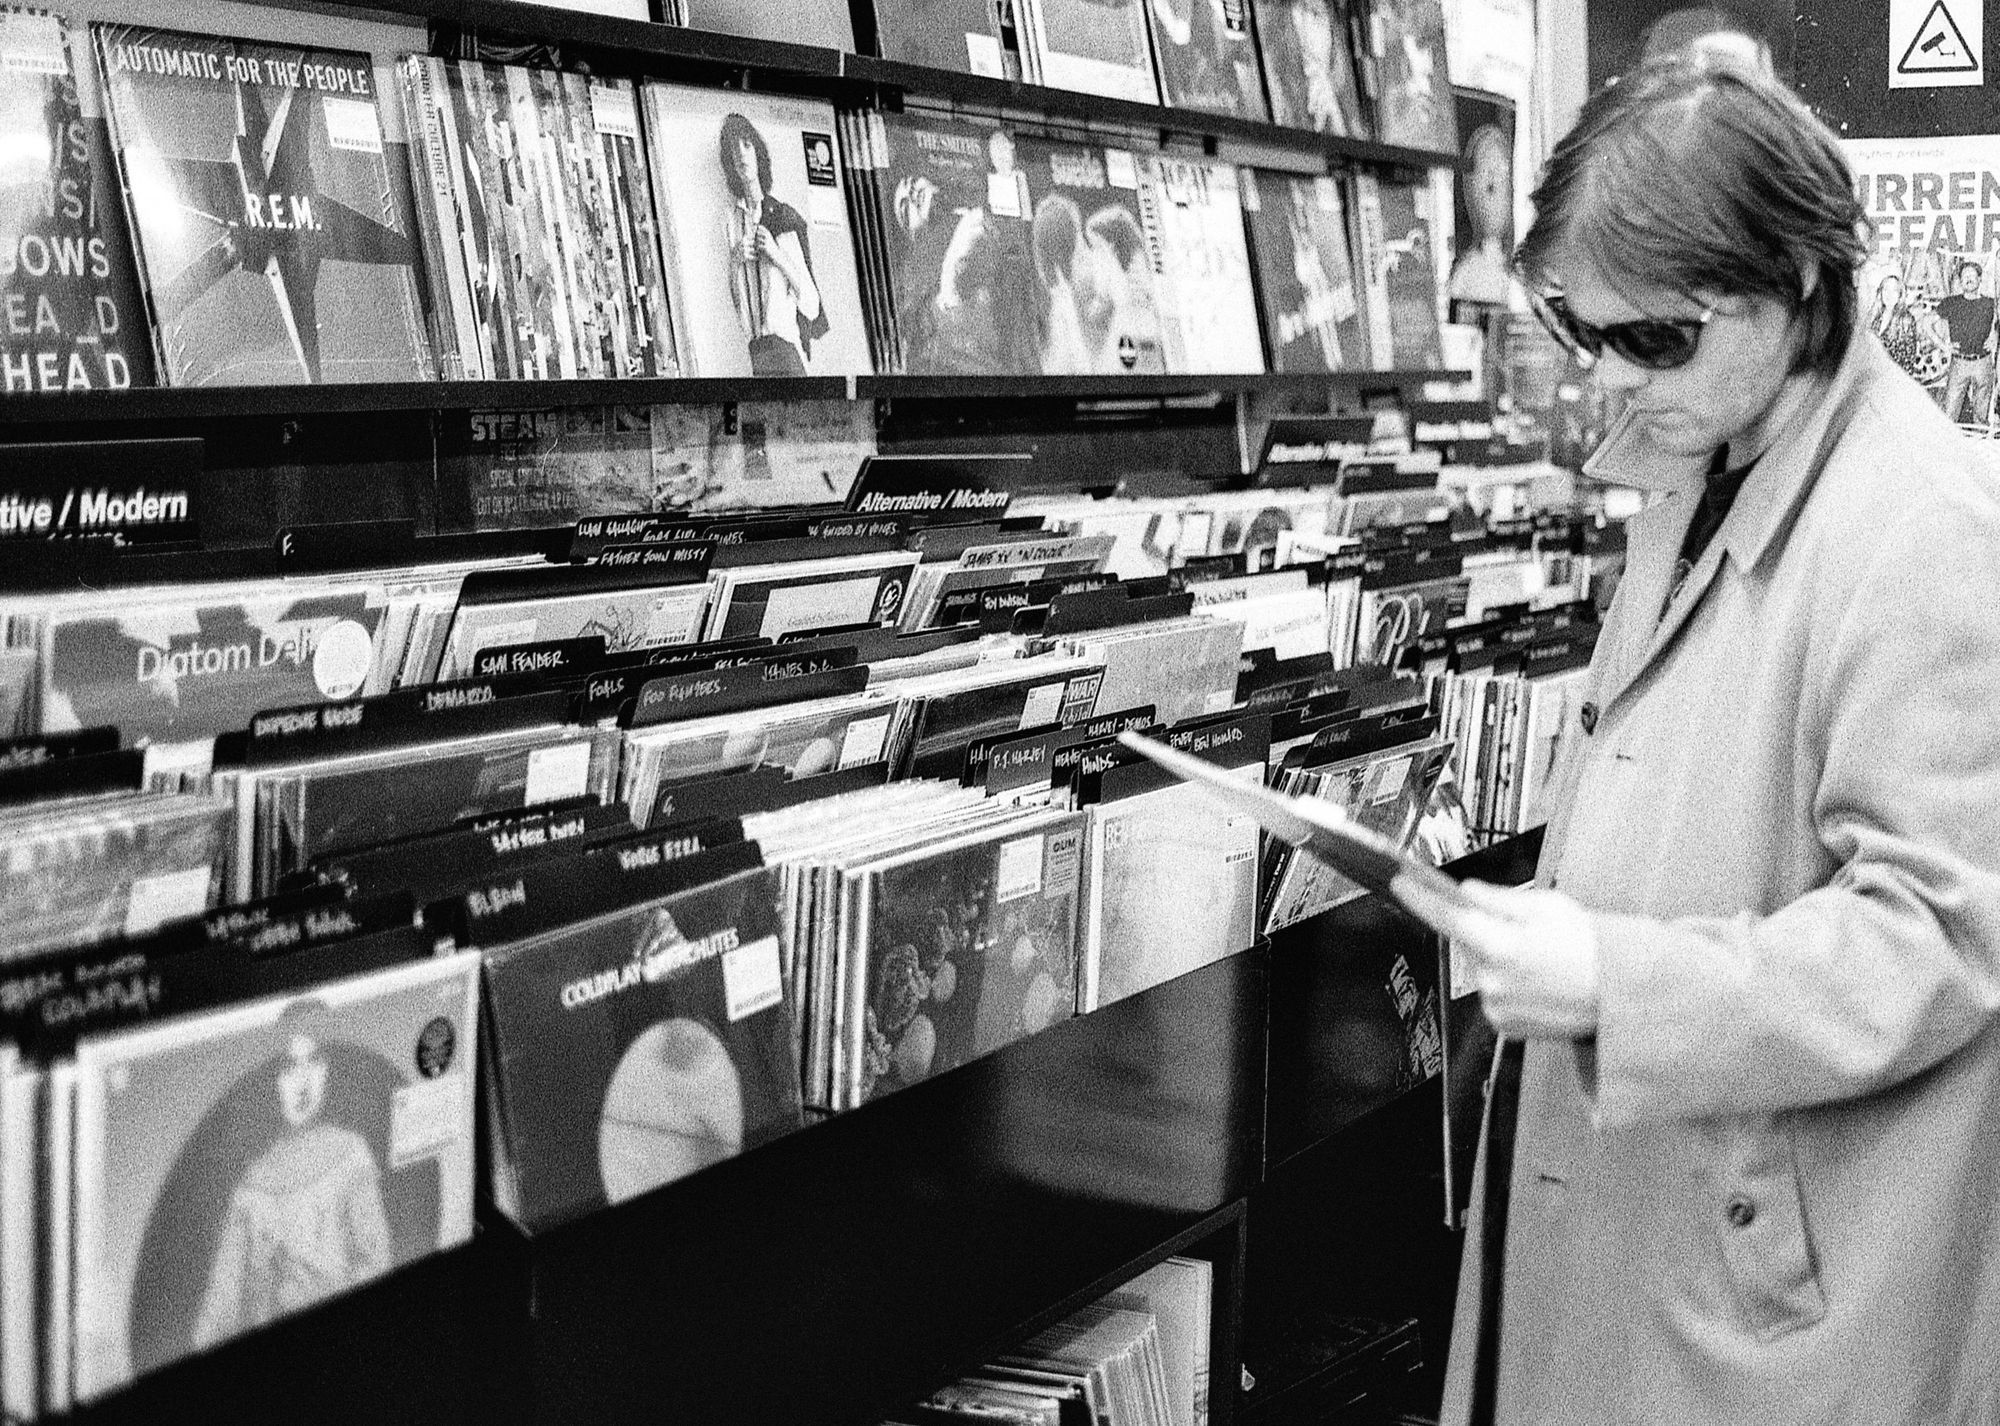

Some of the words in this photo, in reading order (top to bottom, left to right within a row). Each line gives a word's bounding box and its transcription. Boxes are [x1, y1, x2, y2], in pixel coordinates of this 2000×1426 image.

[115, 44, 221, 80] AUTOMATIC
[227, 56, 261, 85] FOR
[265, 60, 301, 89] THE
[304, 64, 370, 95] PEOPLE
[415, 58, 437, 119] COUNTER
[426, 122, 447, 176] CULTURE
[246, 193, 322, 230] R.E.M.
[471, 412, 556, 441] STEAM
[79, 486, 188, 525] Modern
[857, 491, 940, 513] Alternative
[952, 488, 1008, 509] Modern
[600, 549, 641, 566] FATHER
[643, 549, 670, 565] JOHN
[673, 547, 708, 562] MISTY
[137, 641, 250, 682] Diatom
[480, 653, 510, 674] SAM
[589, 678, 625, 701] FOALS
[1069, 677, 1098, 704] WAR
[254, 711, 318, 737] DEPECHE
[970, 740, 990, 764] HAI
[1194, 734, 1211, 752] BEN
[561, 961, 642, 1011] COLDPLAY
[642, 927, 740, 983] CHUTES
